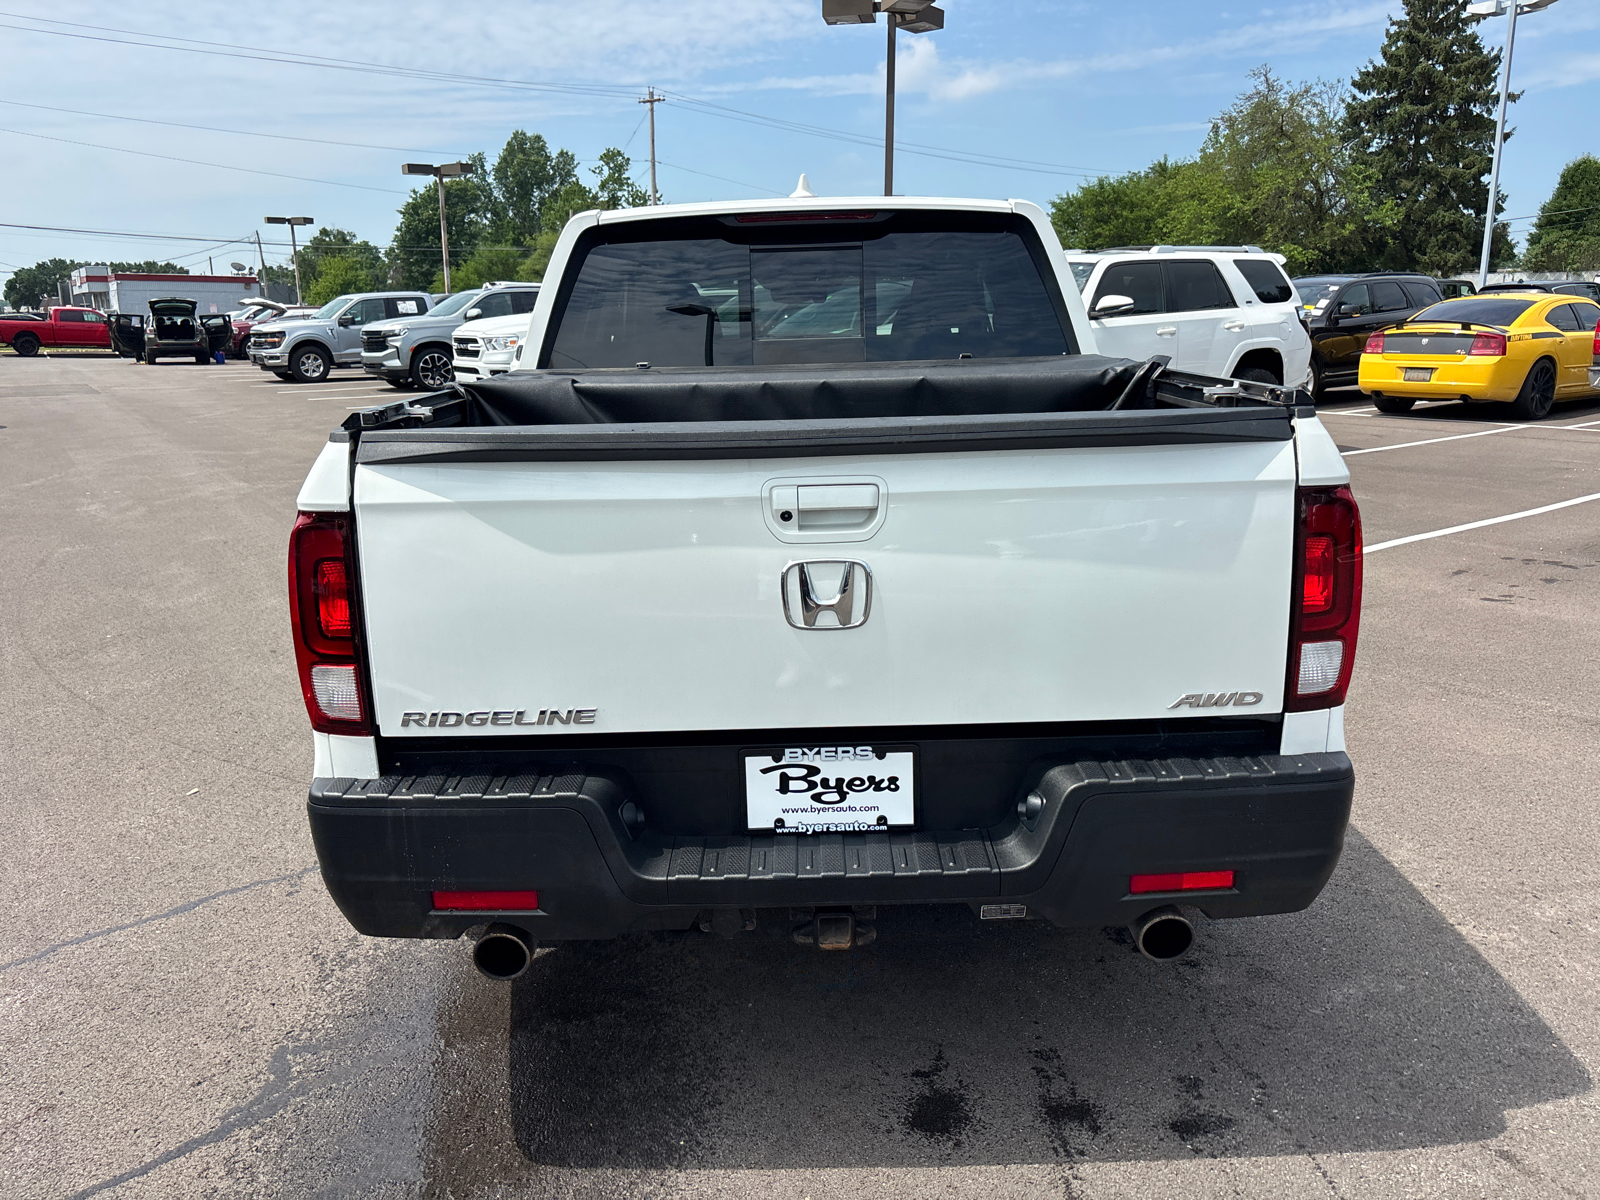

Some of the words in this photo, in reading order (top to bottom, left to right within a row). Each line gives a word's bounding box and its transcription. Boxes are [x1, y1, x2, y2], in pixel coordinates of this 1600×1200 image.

[1167, 690, 1263, 709] AWD
[400, 707, 598, 727] RIDGELINE
[785, 746, 873, 762] BYERS
[759, 763, 900, 805] Byers
[781, 805, 880, 815] www.byersauto.com
[775, 820, 887, 834] www.byersauto.com
